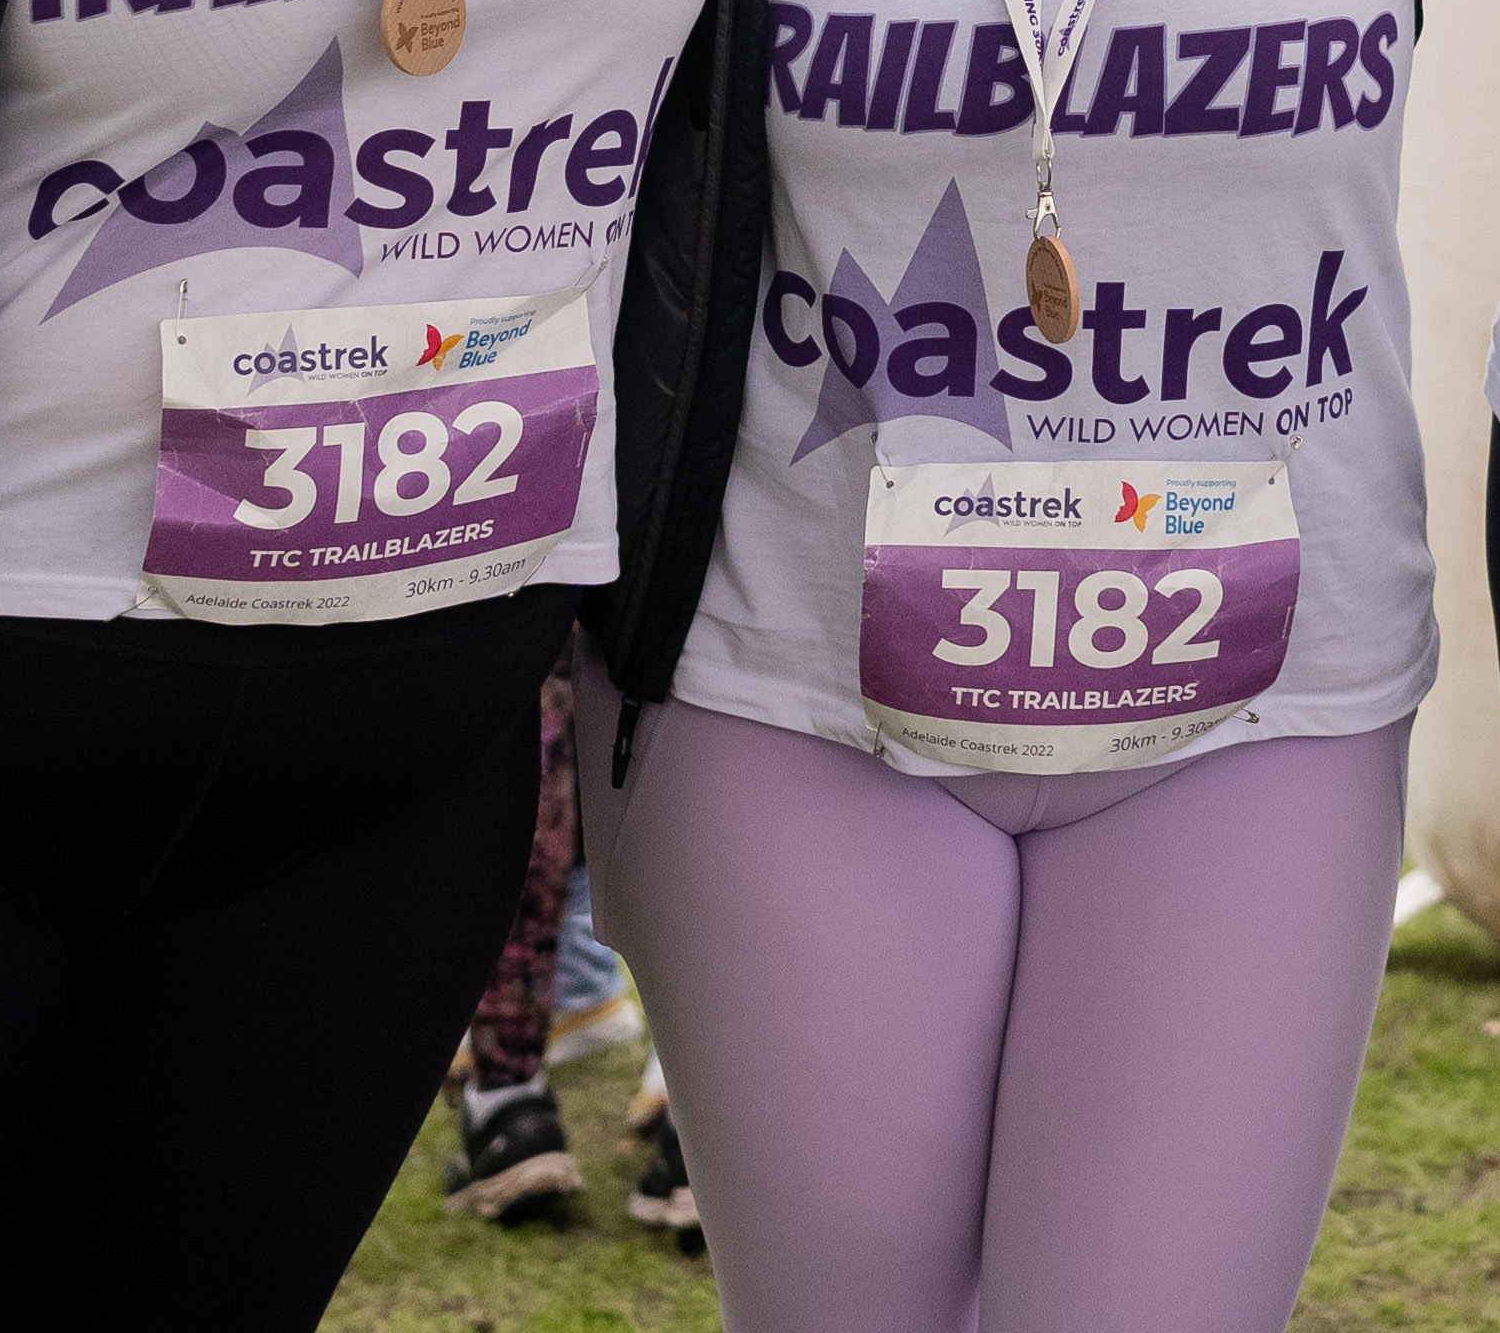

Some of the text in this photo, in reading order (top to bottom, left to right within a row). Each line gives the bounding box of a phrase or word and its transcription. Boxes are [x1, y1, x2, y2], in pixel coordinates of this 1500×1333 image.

[421, 15, 460, 37] Beyond
[421, 37, 444, 51] Blue
[768, 1, 1398, 139] RAILBLAZERS
[381, 231, 460, 262] WILD
[474, 221, 594, 255] WOMEN
[605, 212, 624, 246] ON
[470, 308, 537, 327] Proudly supporting
[762, 250, 1368, 404] coastrek
[466, 320, 532, 349] Beyond
[233, 335, 389, 376] coastrek
[459, 349, 497, 369] Blue
[308, 369, 388, 382] WILD WOMEN ON TOP
[1027, 387, 1353, 444] WILD WOMEN ON TOP
[232, 401, 524, 530] 3182
[1166, 479, 1236, 489] Proudly supporting
[934, 487, 1082, 519] coastrek
[1165, 491, 1234, 516] Beyond
[1003, 519, 1021, 527] WILD
[1165, 515, 1205, 535] Blue
[250, 519, 494, 569] TTC TRAILBLAZERS
[405, 556, 525, 599] 30km 9.30am
[185, 592, 350, 610] Adelaide Coastrek 2022
[932, 568, 1224, 669] 3182
[952, 682, 1199, 710] TTC TRAILBLAZERS
[901, 727, 1054, 757] Adelaide Coastrek 2022
[1110, 733, 1156, 753] 30km
